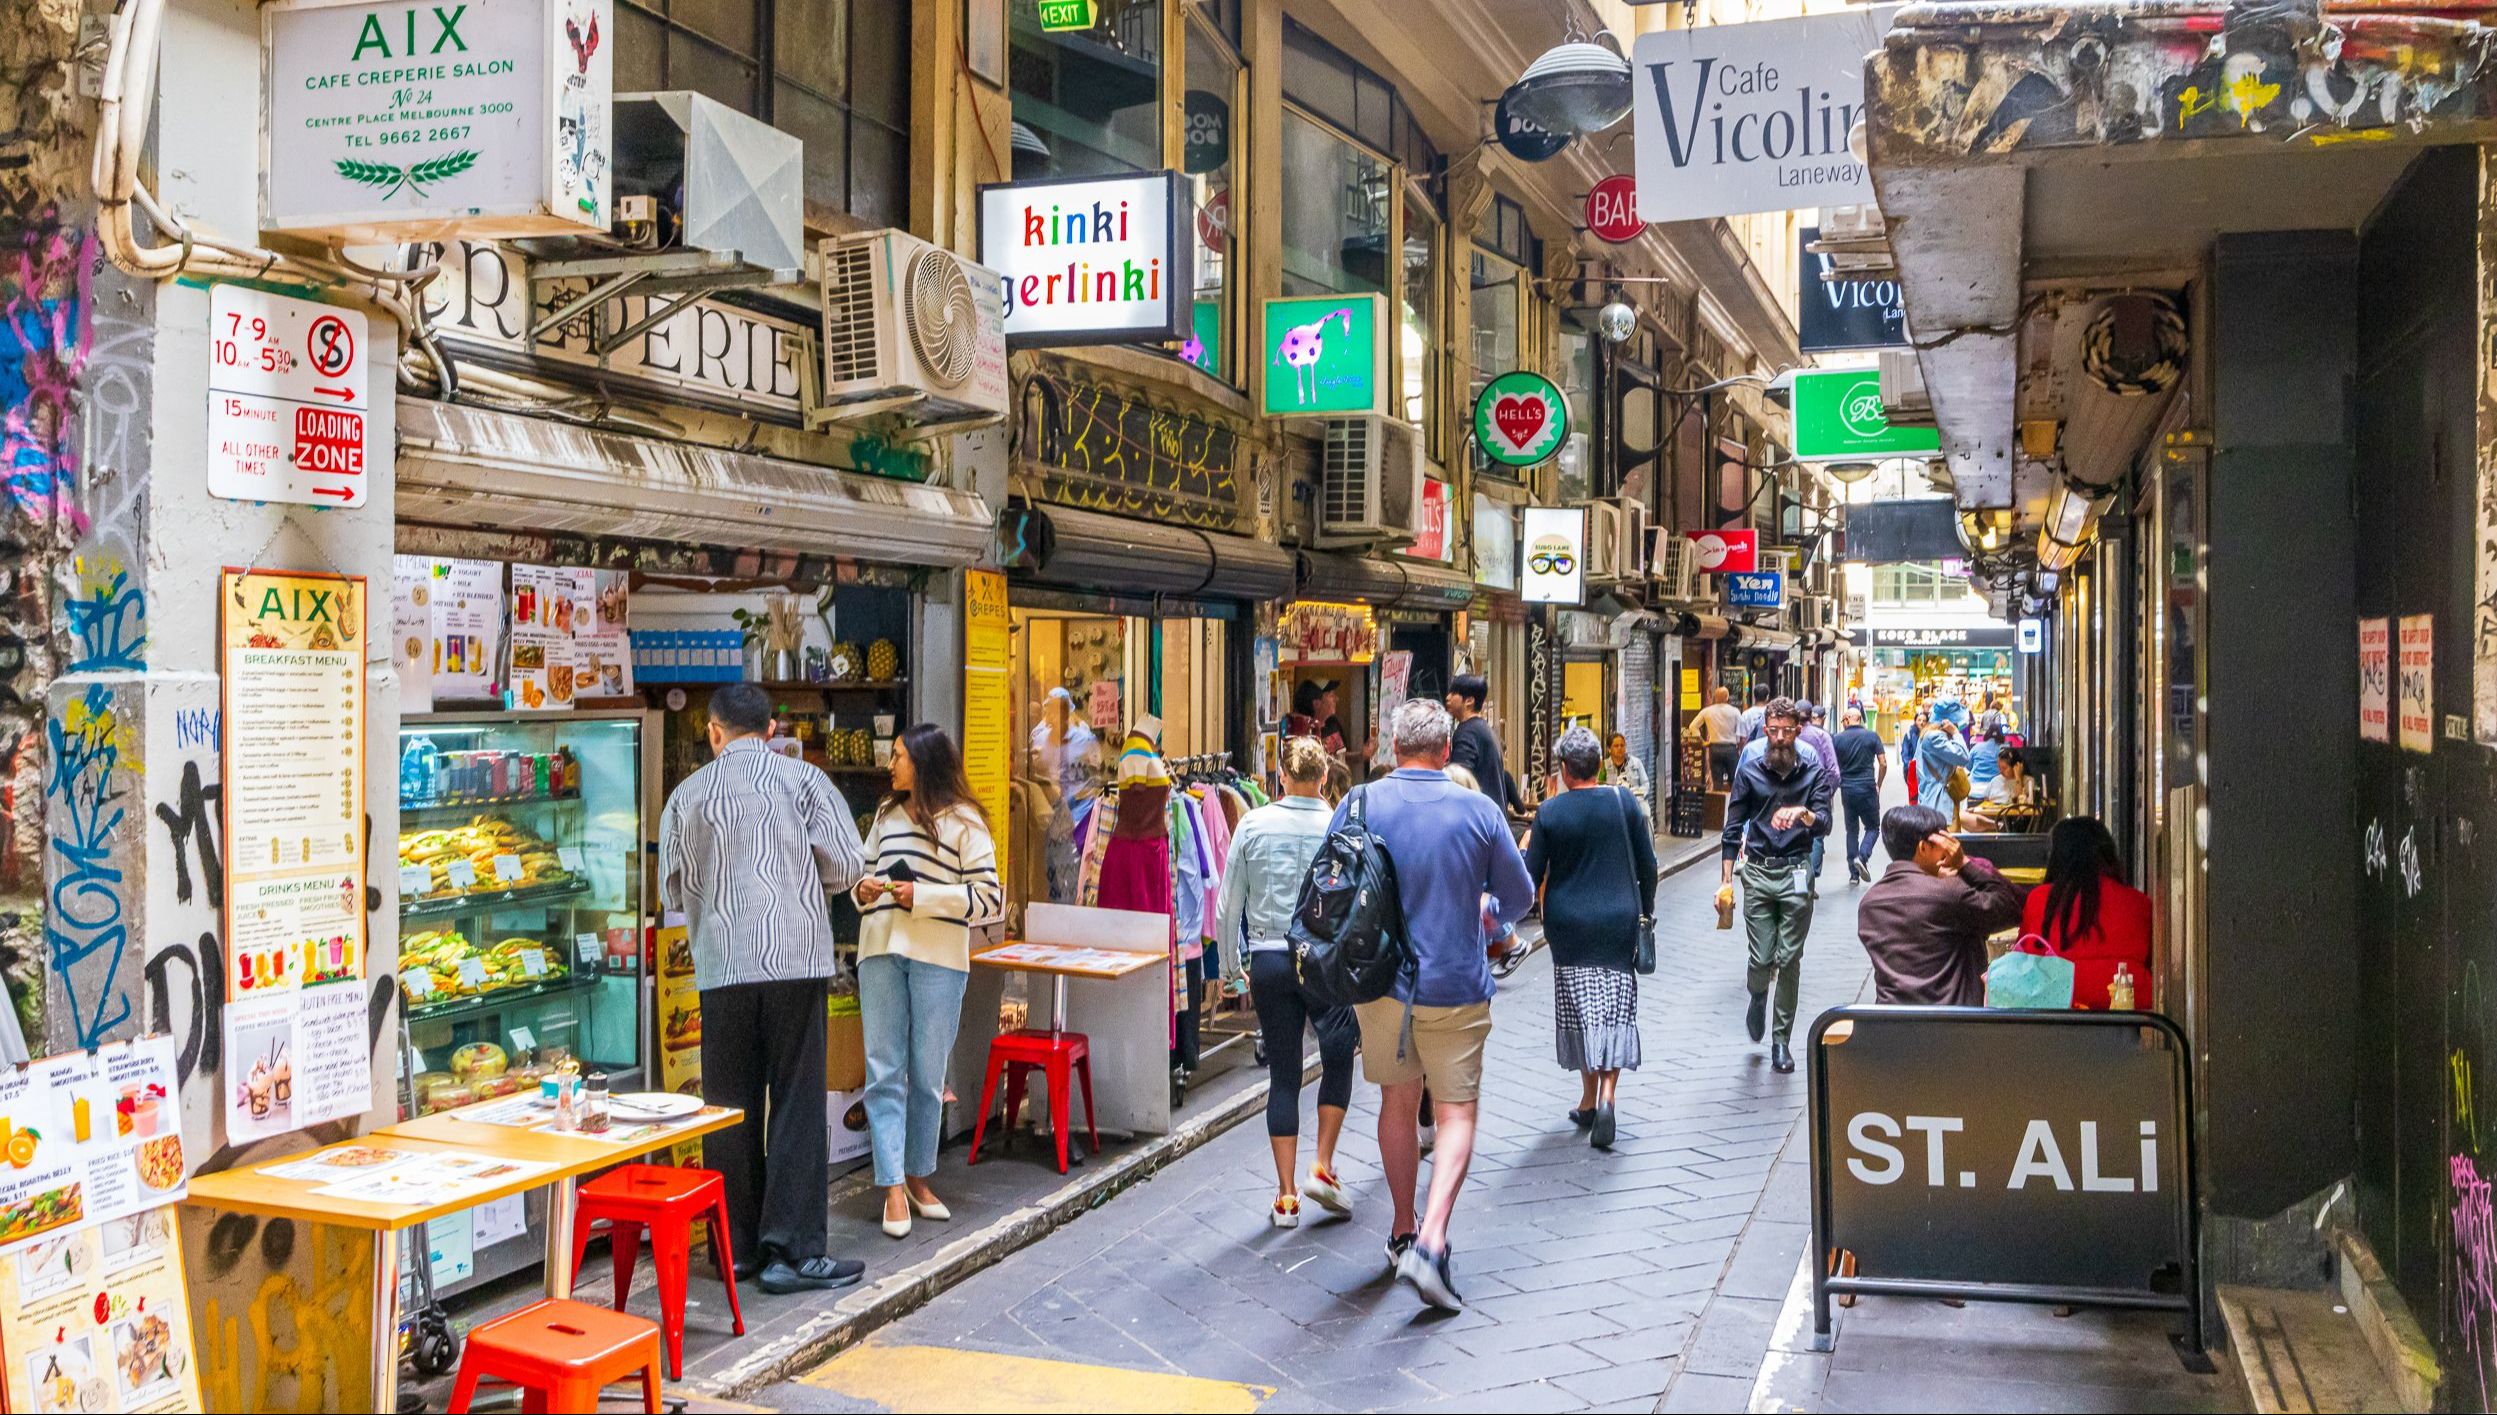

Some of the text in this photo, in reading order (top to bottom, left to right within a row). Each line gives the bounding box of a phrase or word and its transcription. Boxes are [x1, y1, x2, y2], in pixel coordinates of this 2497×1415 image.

[1049, 4, 1079, 24] EXIT
[351, 4, 469, 62] AIX
[305, 59, 515, 91] CAFE CREPERIE SALON
[1718, 60, 1780, 97] Cafe
[305, 102, 514, 129] CENTRE PLACE MELBOURNE 3000
[345, 125, 472, 148] TEL 9662 2667
[1778, 159, 1865, 189] Laneway
[1023, 200, 1128, 247] kinki
[1000, 258, 1160, 319] gerlinki
[214, 340, 237, 366] 10
[224, 399, 278, 423] 15 MINUTE
[1499, 406, 1543, 420] HELL'S
[298, 410, 361, 443] LOADING
[222, 440, 280, 460] ALL OTHER
[295, 443, 363, 473] ZONE
[235, 459, 266, 476] TIMES
[1735, 575, 1774, 590] Yen
[257, 587, 332, 623] AIX
[244, 654, 348, 667] BREAKFAST MENU
[258, 879, 336, 897] DRINKS MENU
[1847, 1112, 2158, 1192] ST. ALi
